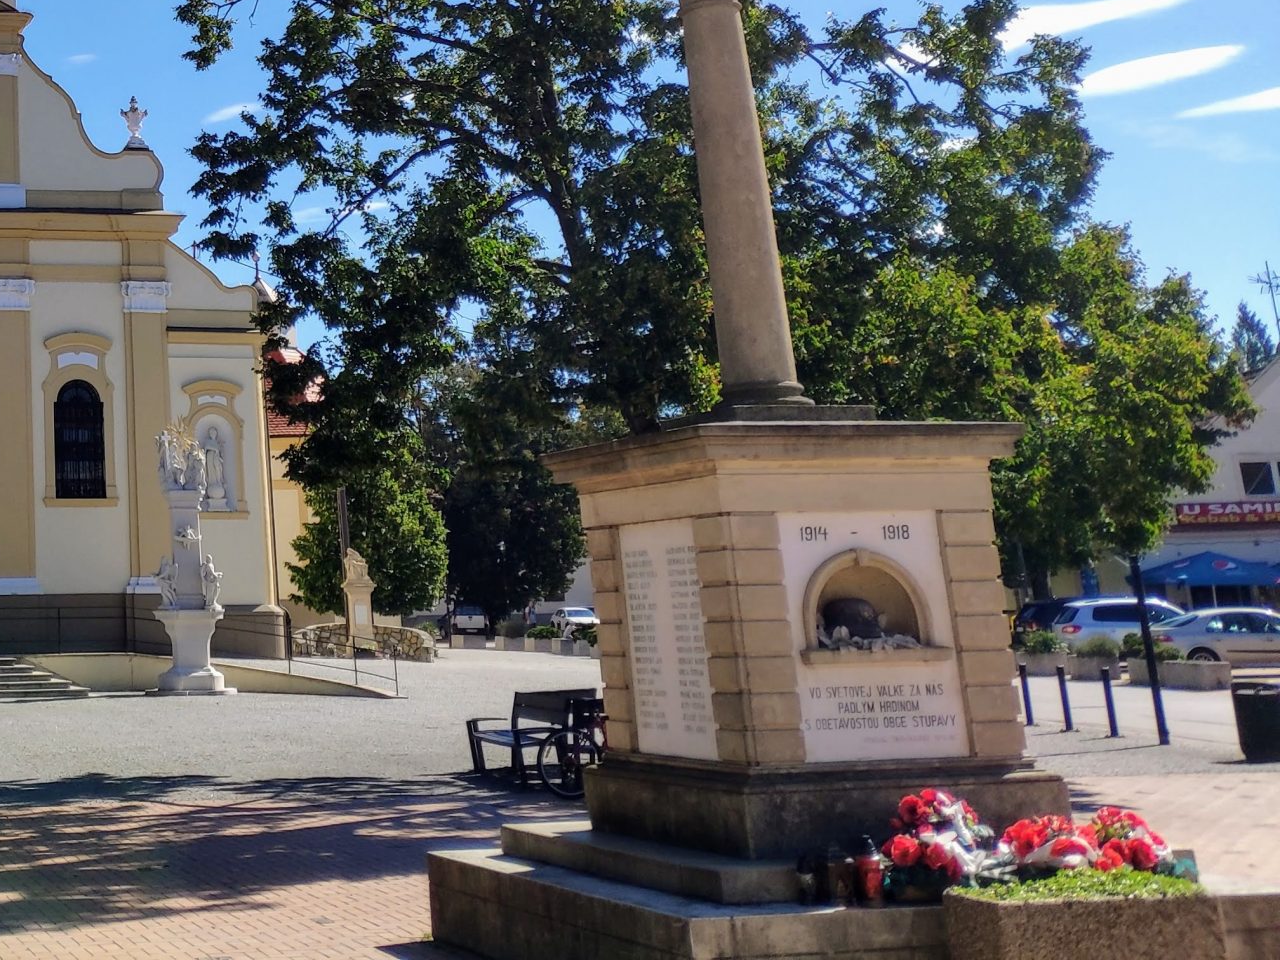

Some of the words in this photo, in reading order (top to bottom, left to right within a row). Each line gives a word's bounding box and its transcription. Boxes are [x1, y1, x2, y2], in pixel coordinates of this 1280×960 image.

[1183, 504, 1200, 514] U
[800, 526, 828, 541] 1914
[882, 524, 910, 540] 1918
[809, 687, 821, 699] VO
[826, 685, 872, 699] SVETOVEJ
[910, 684, 922, 696] ZA
[883, 716, 907, 728] OBCE
[912, 714, 956, 727] STUPAVY
